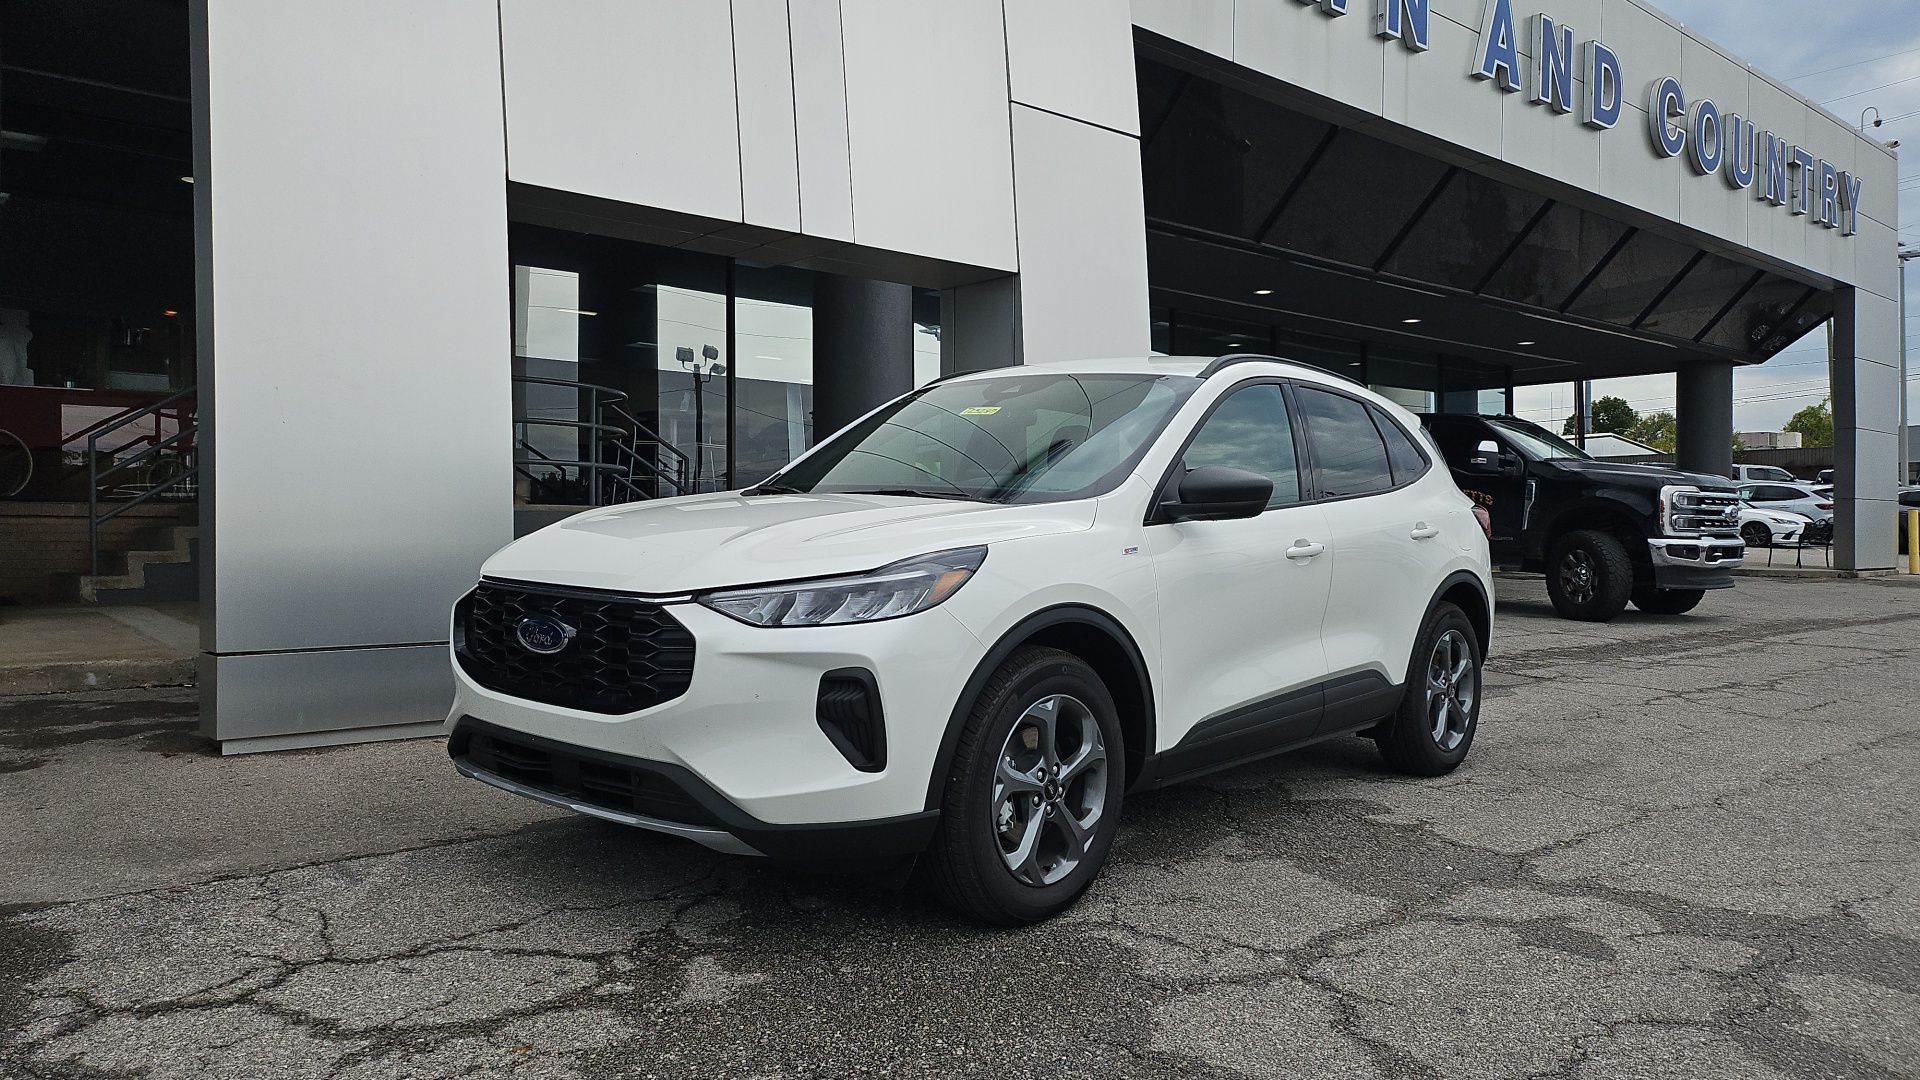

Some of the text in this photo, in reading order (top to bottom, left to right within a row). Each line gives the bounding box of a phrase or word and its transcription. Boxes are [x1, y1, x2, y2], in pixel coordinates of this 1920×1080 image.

[1472, 0, 1863, 236] AND COUNTRY
[526, 625, 553, 645] Ford
